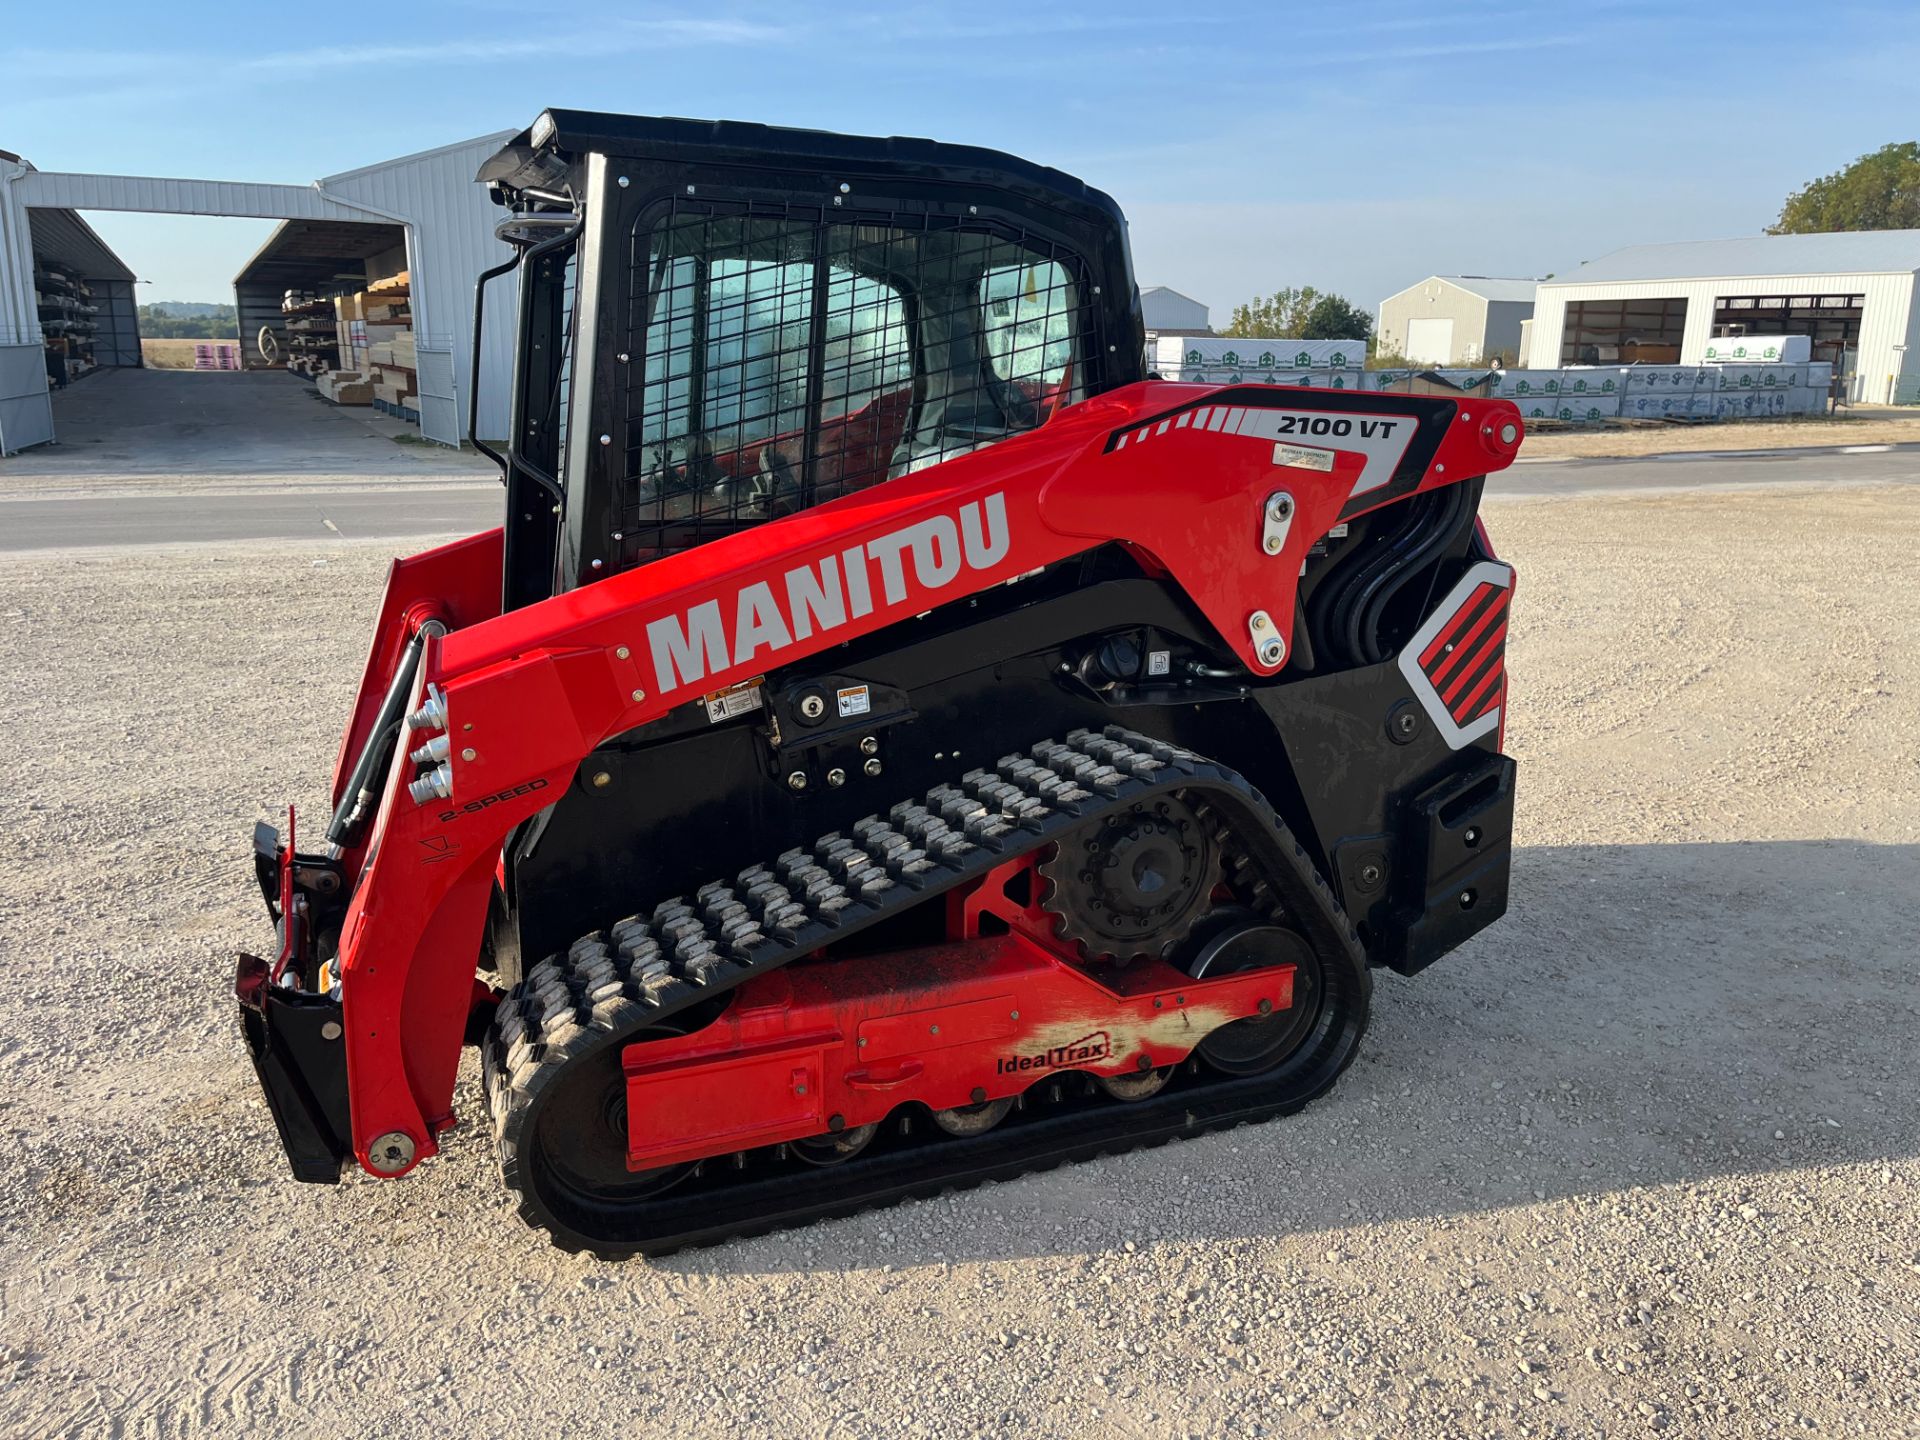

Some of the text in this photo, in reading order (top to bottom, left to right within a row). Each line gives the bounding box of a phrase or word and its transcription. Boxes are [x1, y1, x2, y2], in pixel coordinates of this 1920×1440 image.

[1277, 415, 1398, 439] 2100 VT
[646, 491, 1010, 694] MANITOU
[438, 778, 549, 822] 2-SPEED
[997, 1042, 1104, 1074] IdealTrax
